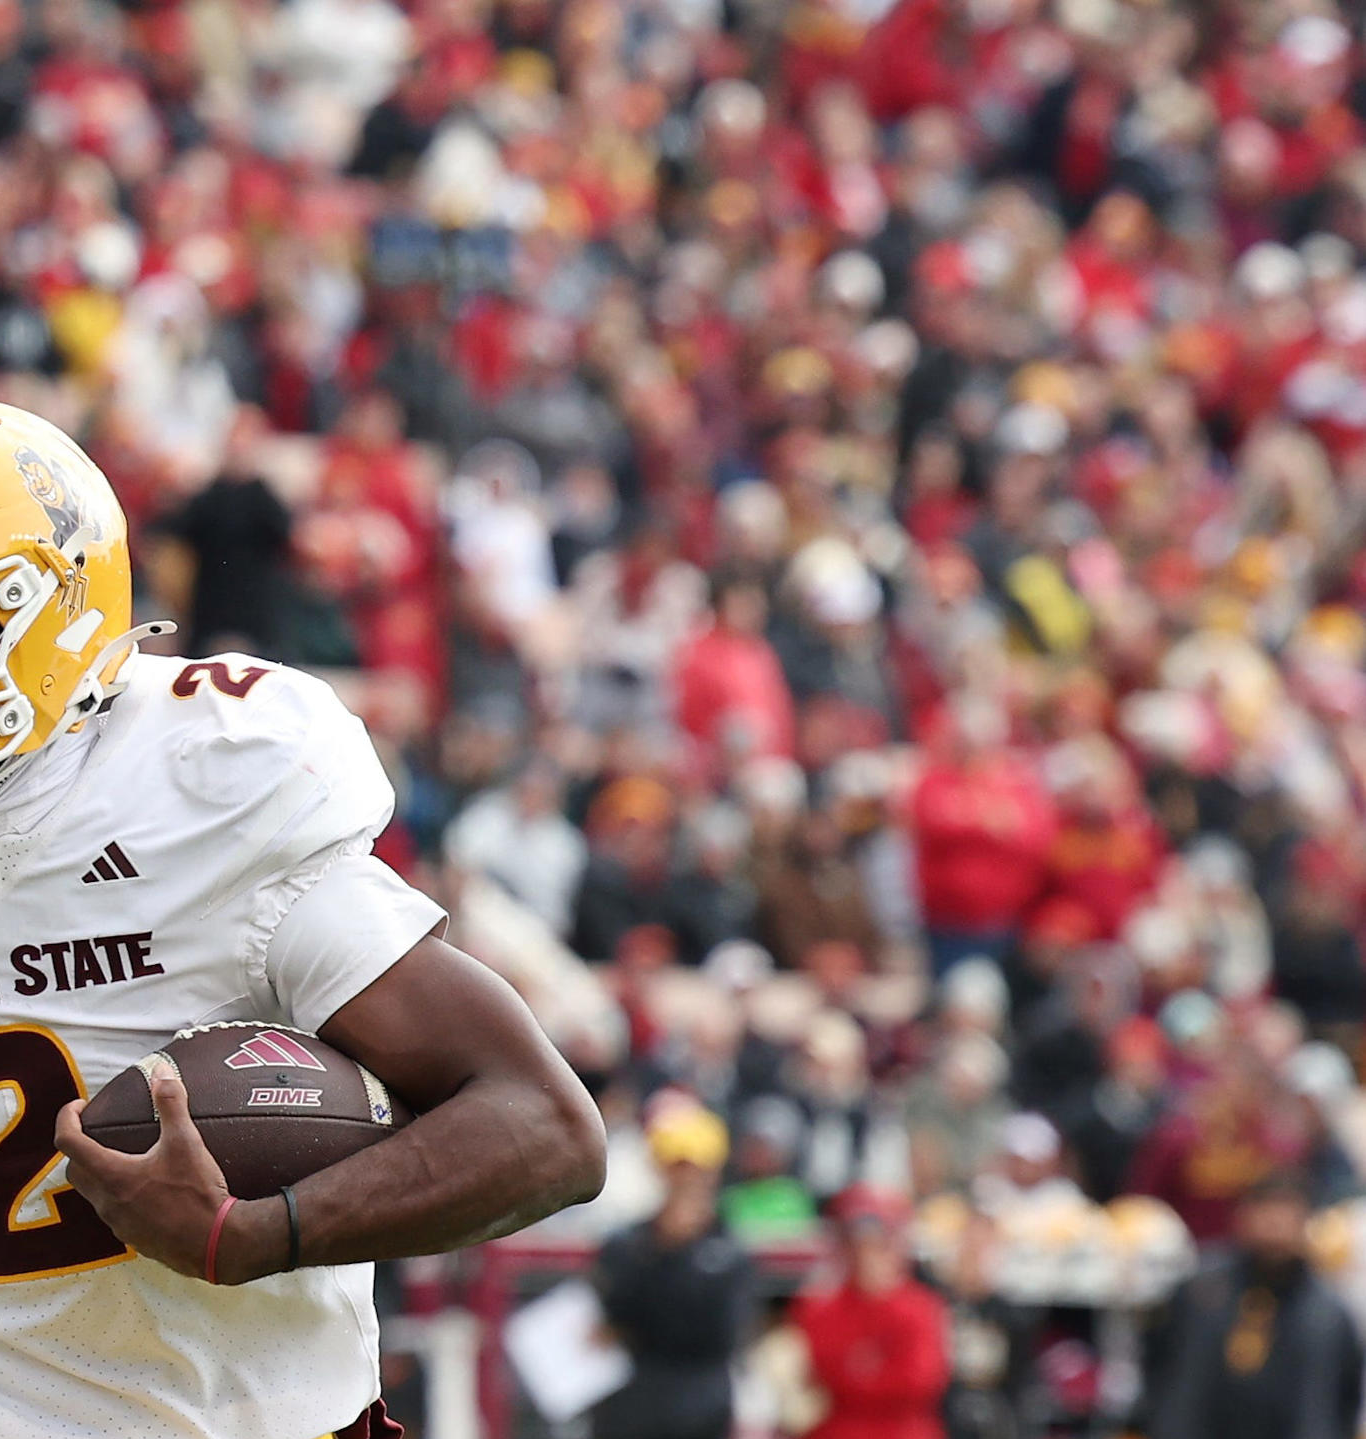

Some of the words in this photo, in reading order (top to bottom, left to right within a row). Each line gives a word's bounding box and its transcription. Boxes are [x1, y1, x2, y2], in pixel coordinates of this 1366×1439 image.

[170, 662, 276, 701] 2
[10, 931, 165, 997] STATE
[247, 1087, 323, 1107] DIME
